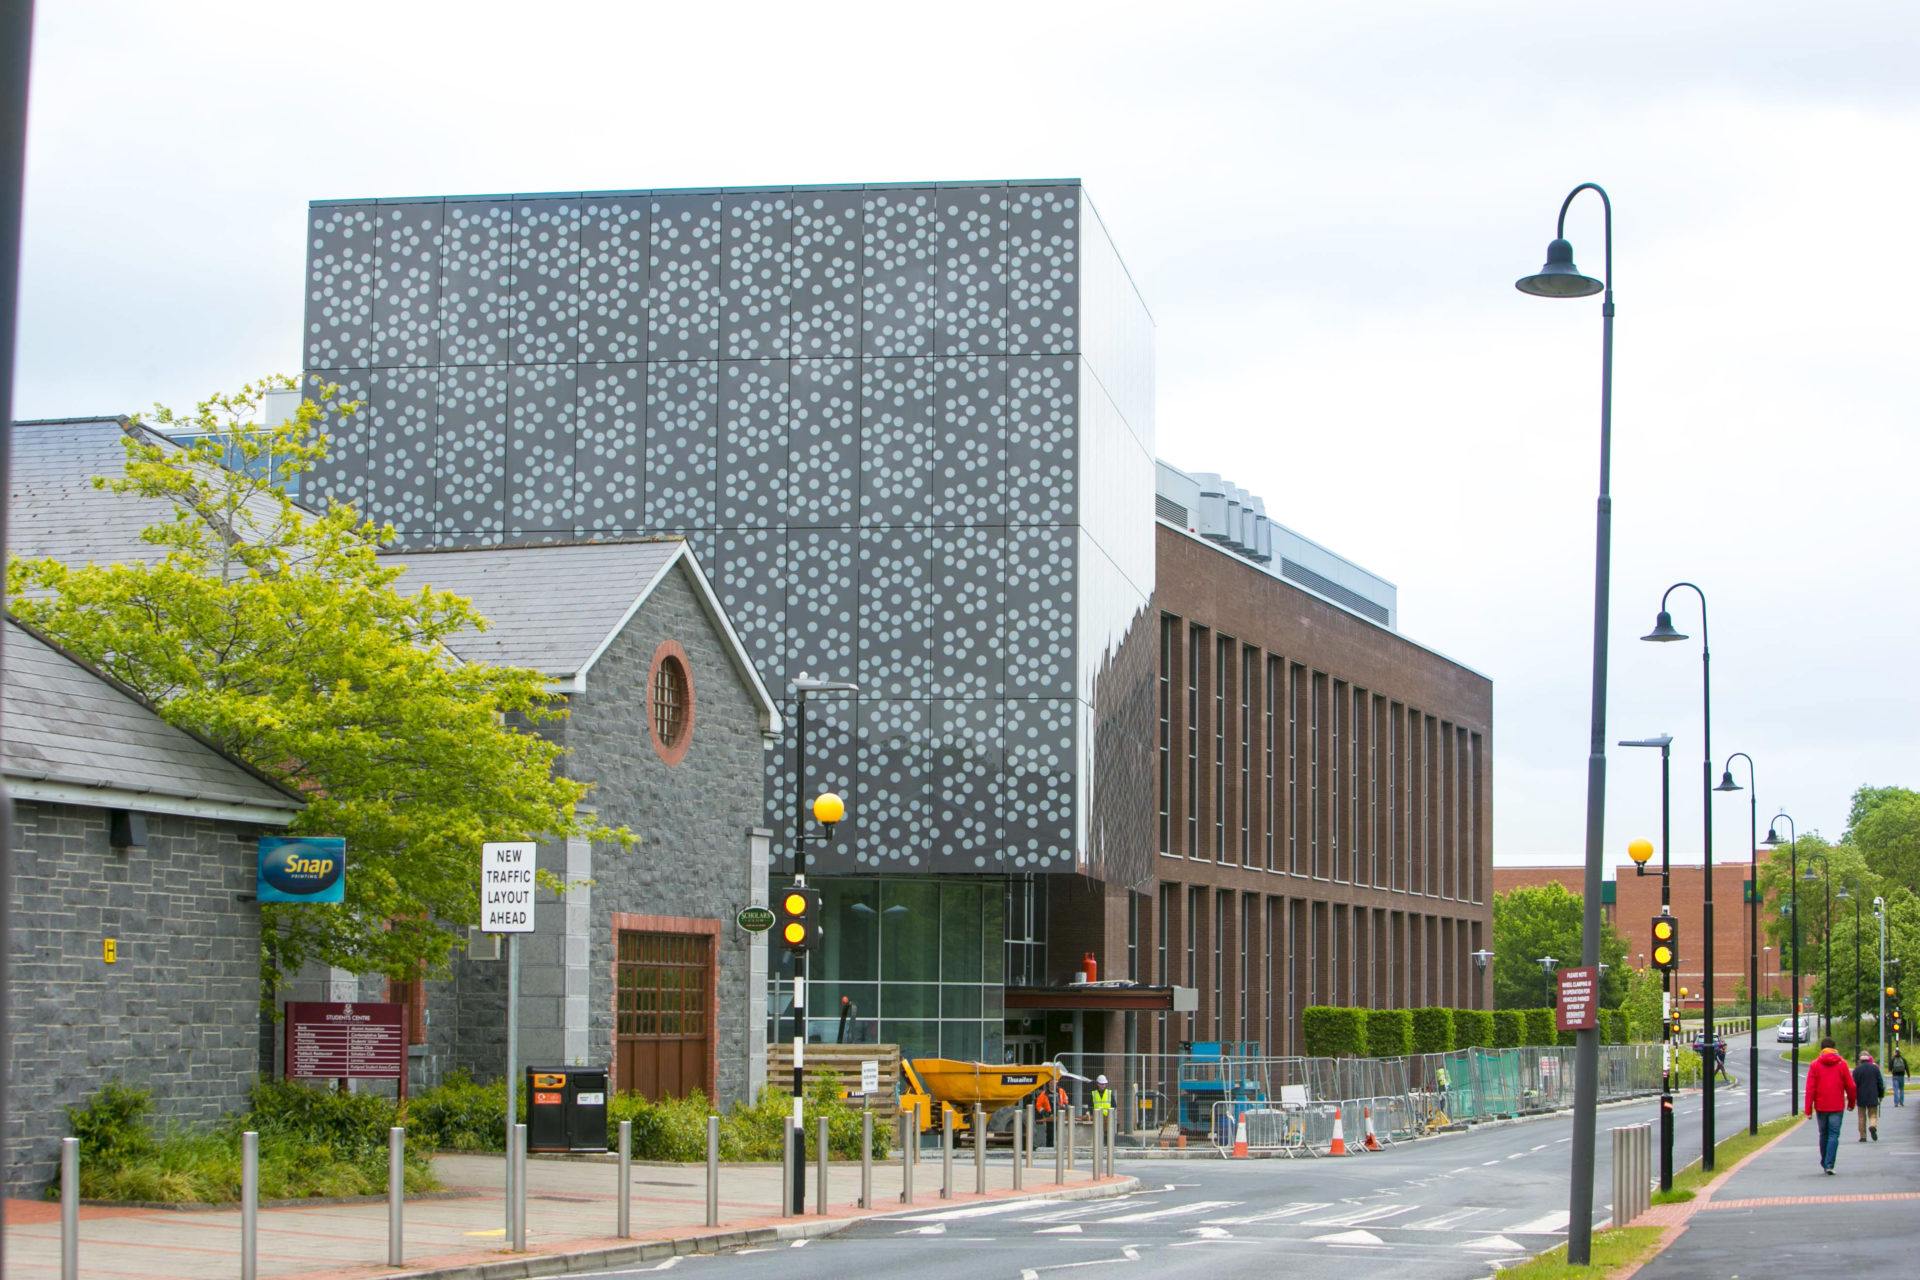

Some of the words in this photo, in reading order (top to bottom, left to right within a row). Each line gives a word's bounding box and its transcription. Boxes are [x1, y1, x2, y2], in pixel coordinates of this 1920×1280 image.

[497, 850, 522, 862] NEW
[284, 854, 333, 879] Snap
[486, 870, 531, 883] TRAFFIC
[488, 891, 529, 904] LAYOUT
[490, 912, 527, 924] AHEAD
